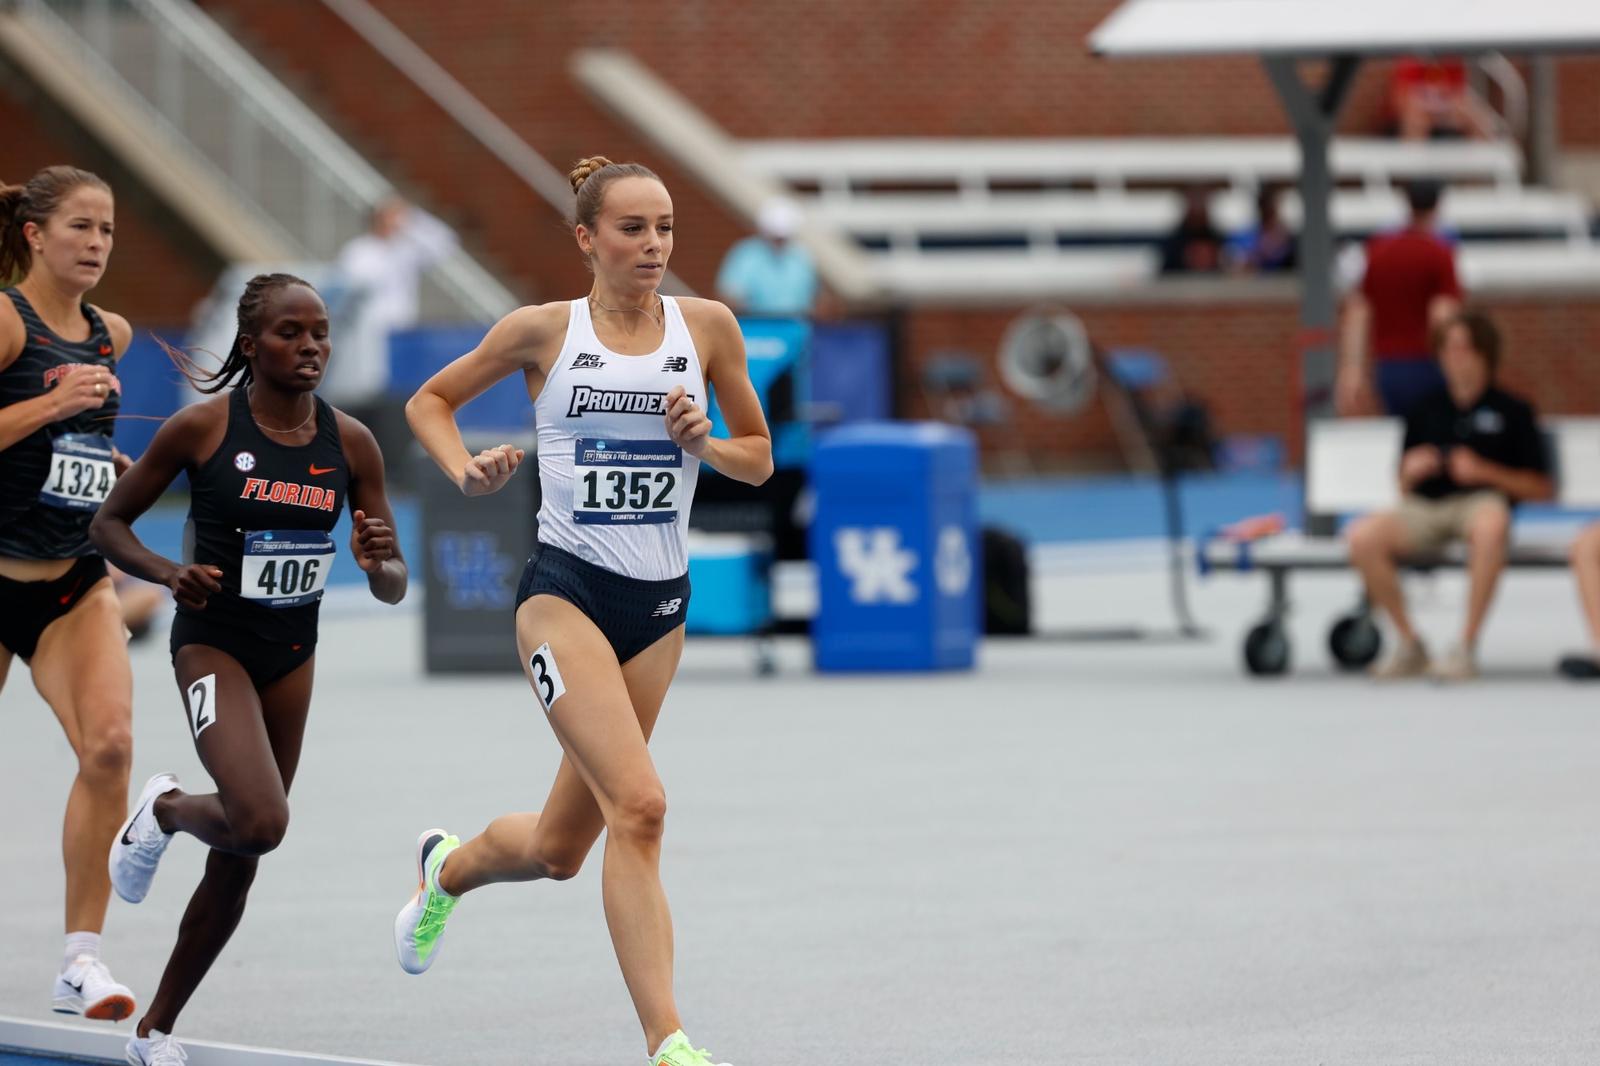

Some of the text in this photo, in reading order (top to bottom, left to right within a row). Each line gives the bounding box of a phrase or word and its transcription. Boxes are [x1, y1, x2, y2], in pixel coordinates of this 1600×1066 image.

[572, 361, 607, 369] EAST
[577, 353, 601, 362] BIG
[52, 459, 109, 499] 1324
[240, 477, 336, 512] FLORIDA
[583, 470, 676, 510] 1352
[258, 559, 320, 595] 406
[531, 653, 555, 706] 3
[192, 682, 209, 732] 2
